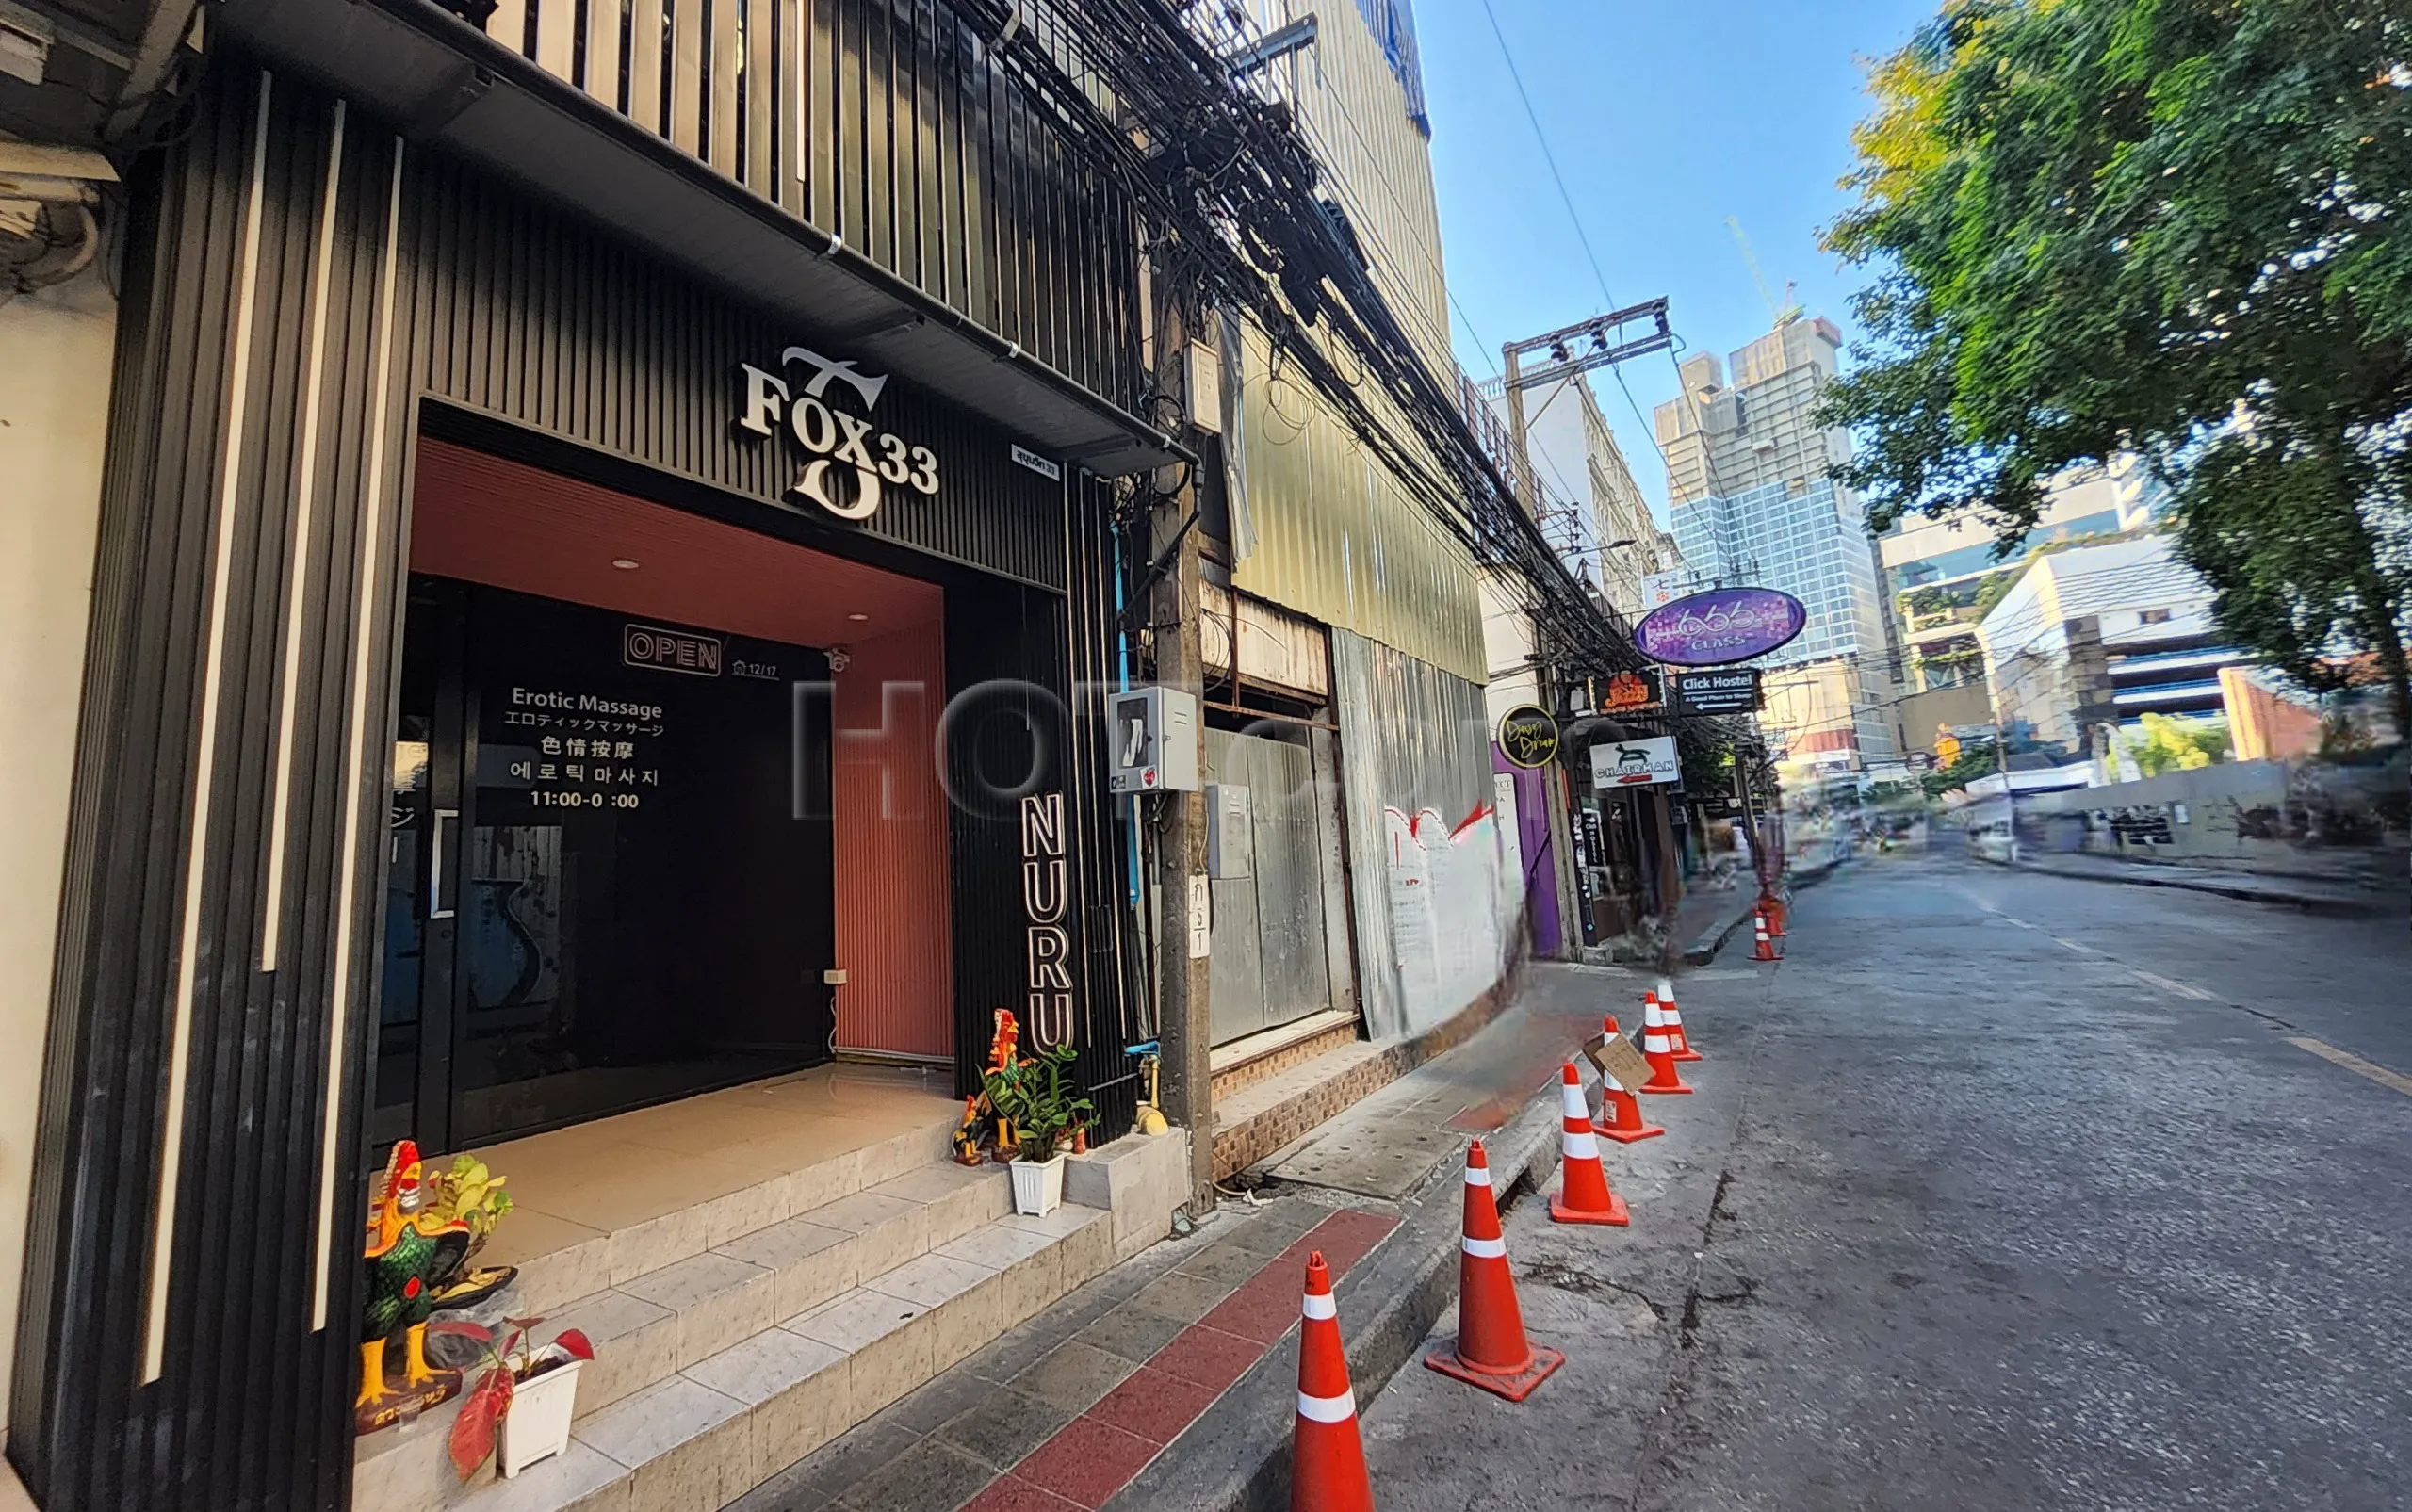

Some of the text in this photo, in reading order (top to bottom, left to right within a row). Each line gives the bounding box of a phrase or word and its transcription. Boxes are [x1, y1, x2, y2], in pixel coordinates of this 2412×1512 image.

[628, 632, 718, 670] OPEN
[1691, 635, 1746, 651] CLASS
[1682, 674, 1752, 690] Click Hostel
[513, 687, 662, 720] Erotic Massage
[504, 711, 664, 737] エロティックマッサージ
[541, 736, 633, 759] 色情按摩
[1594, 759, 1673, 779] CHAIRMAN
[1021, 791, 1073, 1057] NURU
